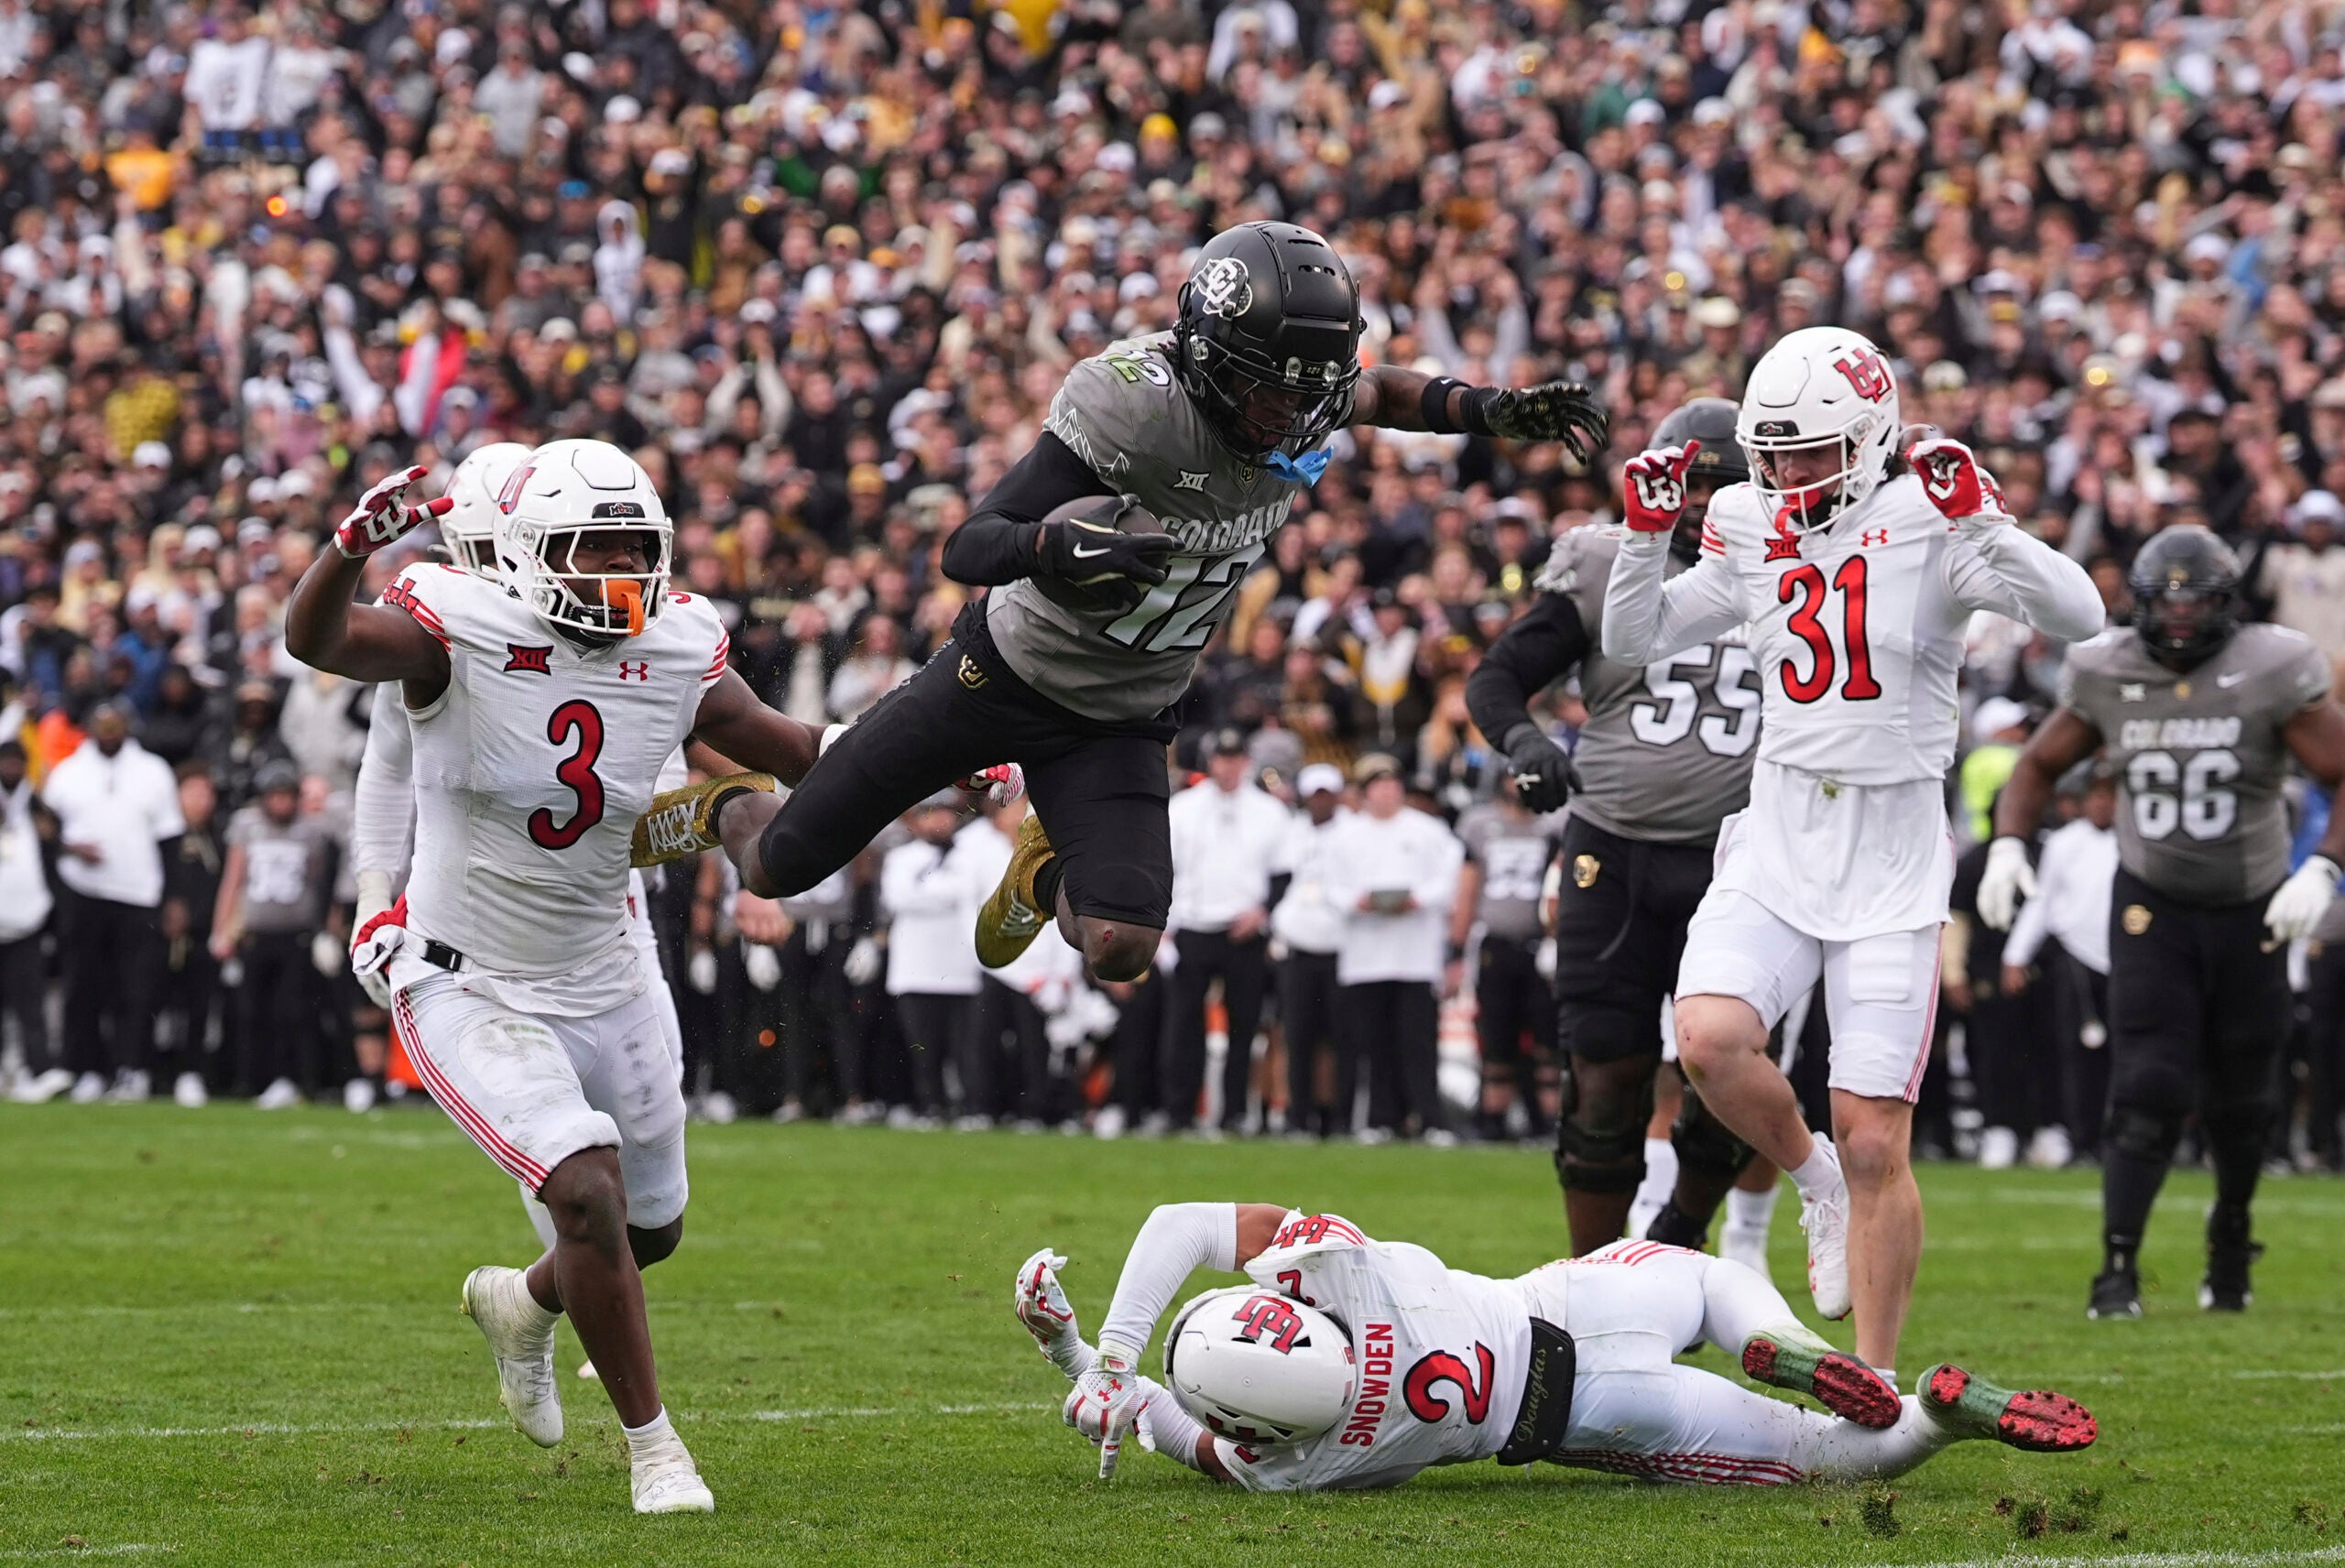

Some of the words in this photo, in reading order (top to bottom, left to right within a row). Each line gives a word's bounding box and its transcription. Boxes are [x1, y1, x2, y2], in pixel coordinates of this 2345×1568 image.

[1099, 350, 1171, 387] 12
[1161, 490, 1296, 554] COLORADO
[1172, 470, 1209, 493] XII
[1098, 538, 1268, 653] 12
[1778, 554, 1882, 703] 31
[504, 643, 554, 675] XII
[1630, 642, 1762, 757] 55
[527, 699, 605, 850] 3
[2121, 716, 2242, 749] COLORADO
[2127, 749, 2242, 842] 66
[1339, 1323, 1394, 1447] SNOWDEN
[1402, 1340, 1496, 1425] 2
[1514, 1347, 1551, 1443] Douglas
